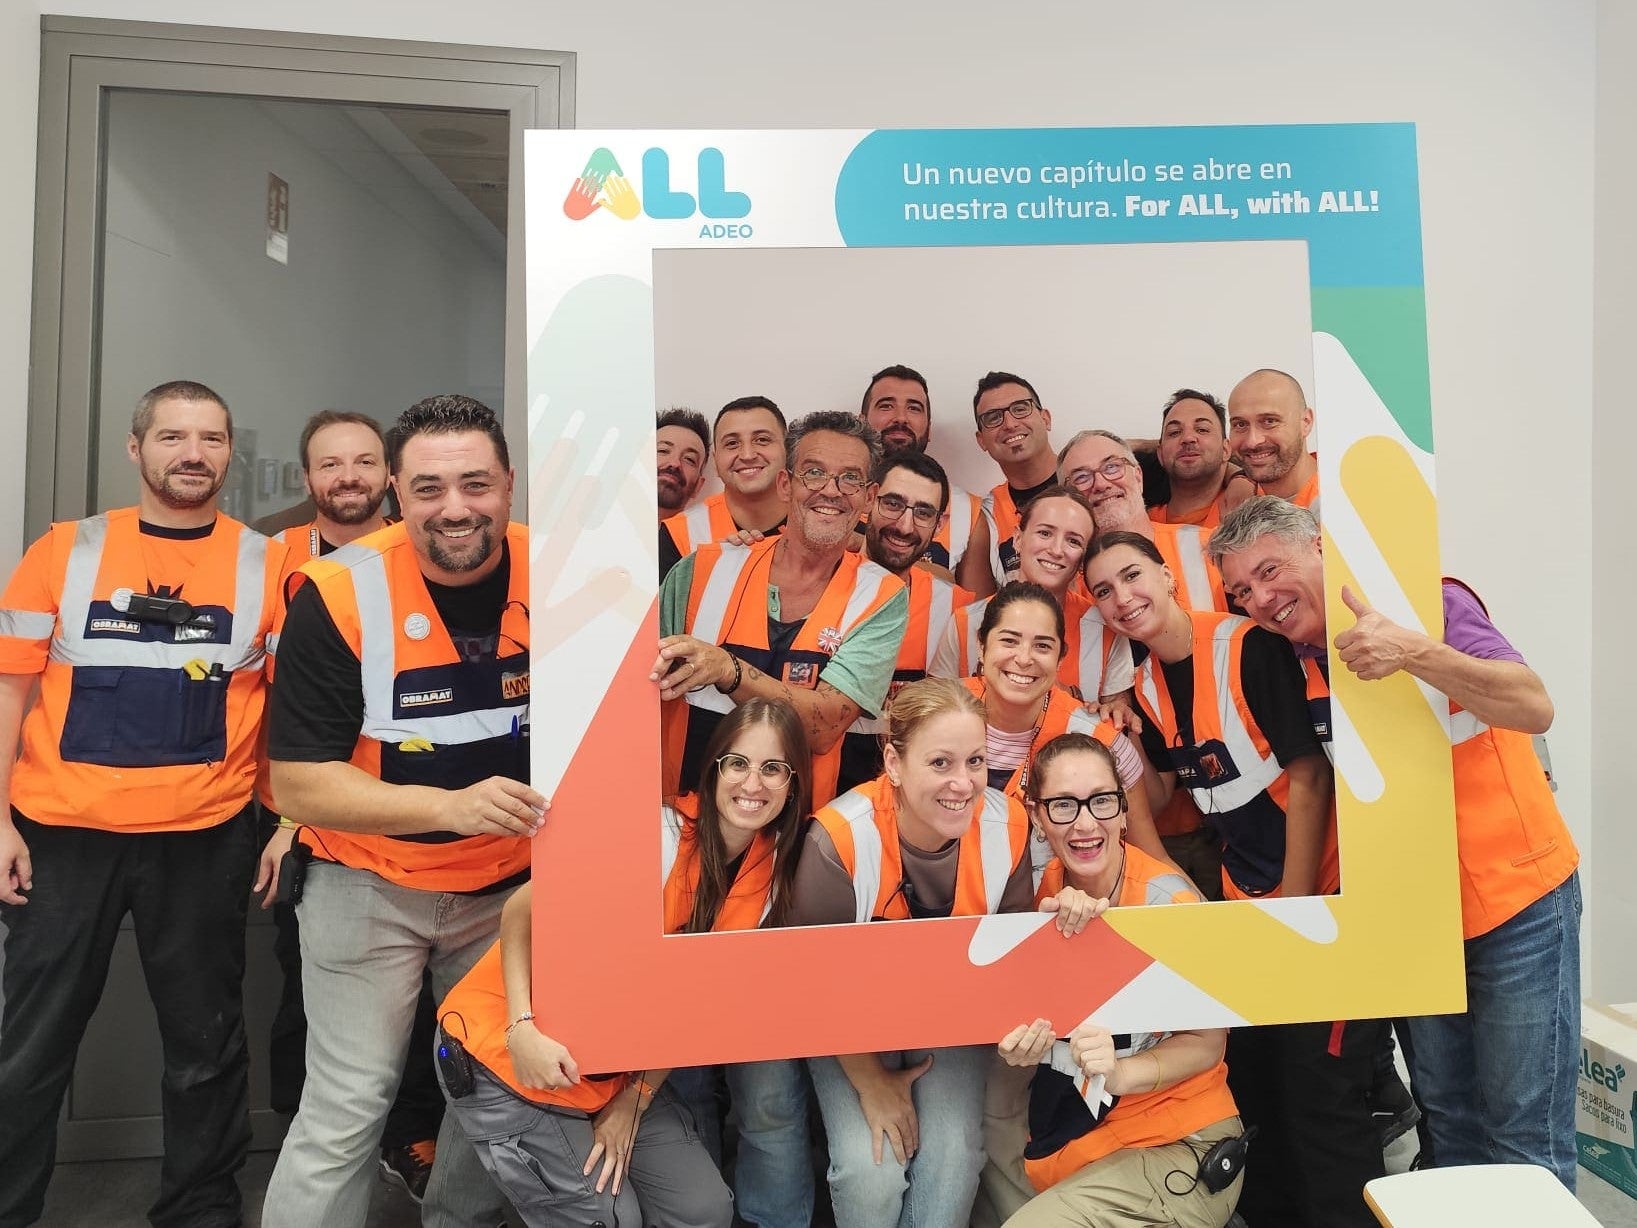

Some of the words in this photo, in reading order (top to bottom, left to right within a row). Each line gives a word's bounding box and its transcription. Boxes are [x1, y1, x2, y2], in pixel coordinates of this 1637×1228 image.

[563, 147, 752, 221] ALL
[903, 163, 940, 185] Un
[949, 167, 1032, 185] nuevo
[1040, 159, 1146, 188] capítulo
[1154, 164, 1184, 182] se
[1192, 158, 1252, 181] abre
[1260, 163, 1292, 180] en
[904, 197, 1008, 221] nuestra
[1016, 195, 1118, 219] cultura.
[1125, 195, 1171, 217] For
[1178, 194, 1239, 220] ALL,
[1246, 191, 1311, 215] with
[1318, 190, 1380, 213] ALL!
[699, 224, 753, 239] ADEO
